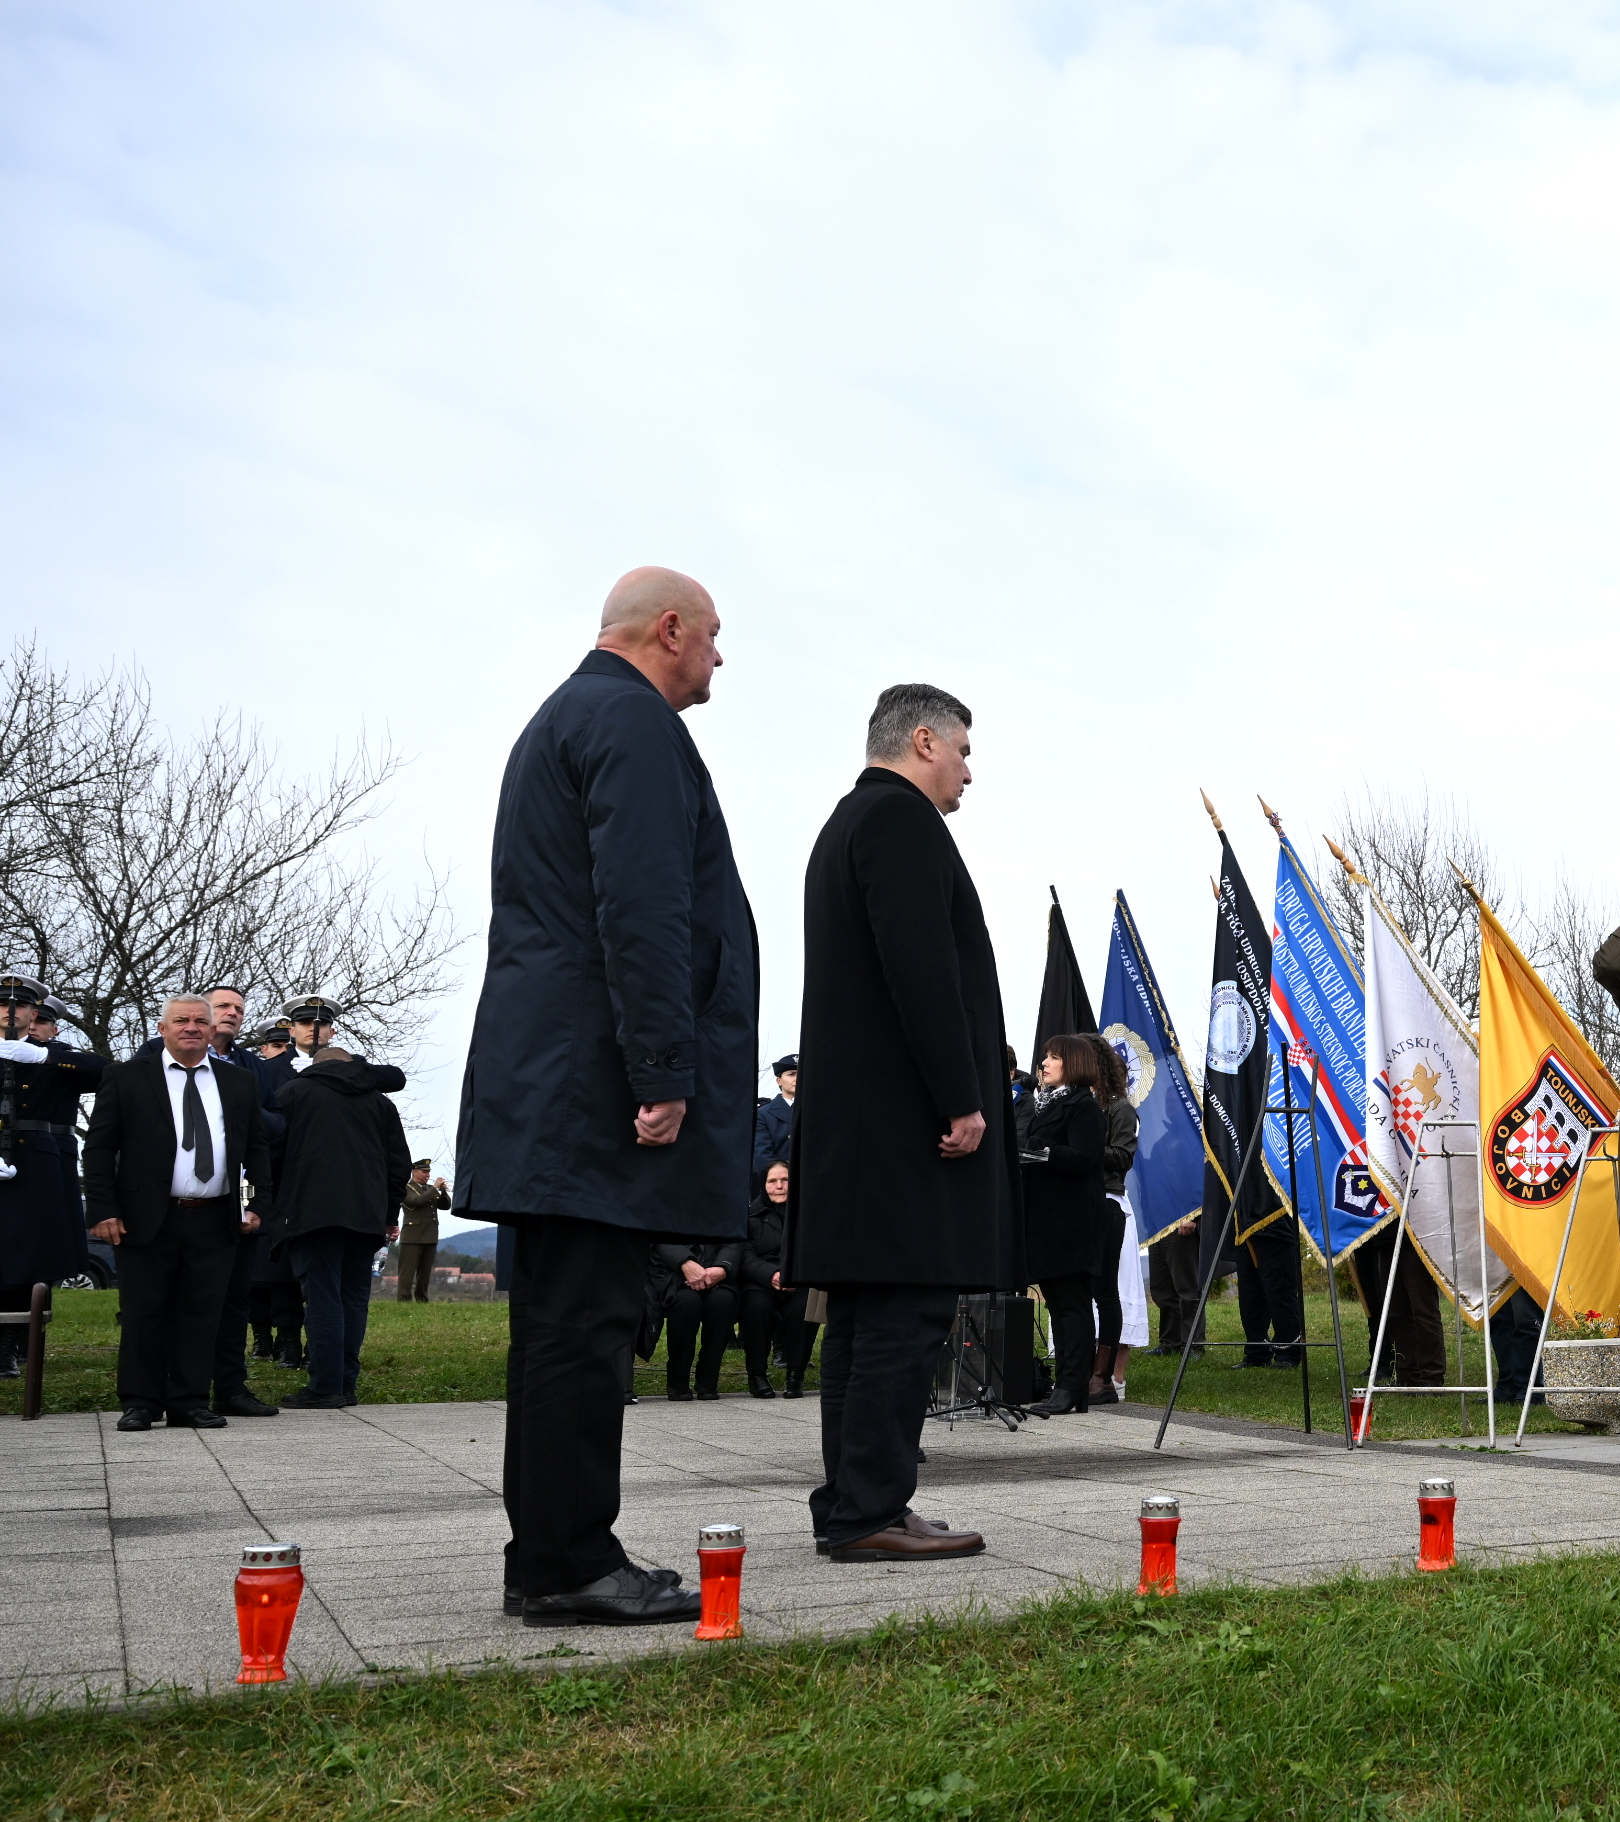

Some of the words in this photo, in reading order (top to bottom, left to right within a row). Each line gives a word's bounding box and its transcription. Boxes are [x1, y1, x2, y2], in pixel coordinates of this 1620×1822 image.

[1241, 937, 1264, 987] UDRUGA
[1276, 879, 1310, 942] UDRUGA
[1302, 927, 1345, 1002] HRVATSKIH
[1317, 1018, 1352, 1080] STRESNOG
[1208, 1094, 1238, 1146] DOMOVINI
[1493, 1108, 1572, 1199] BOJOVNICI
